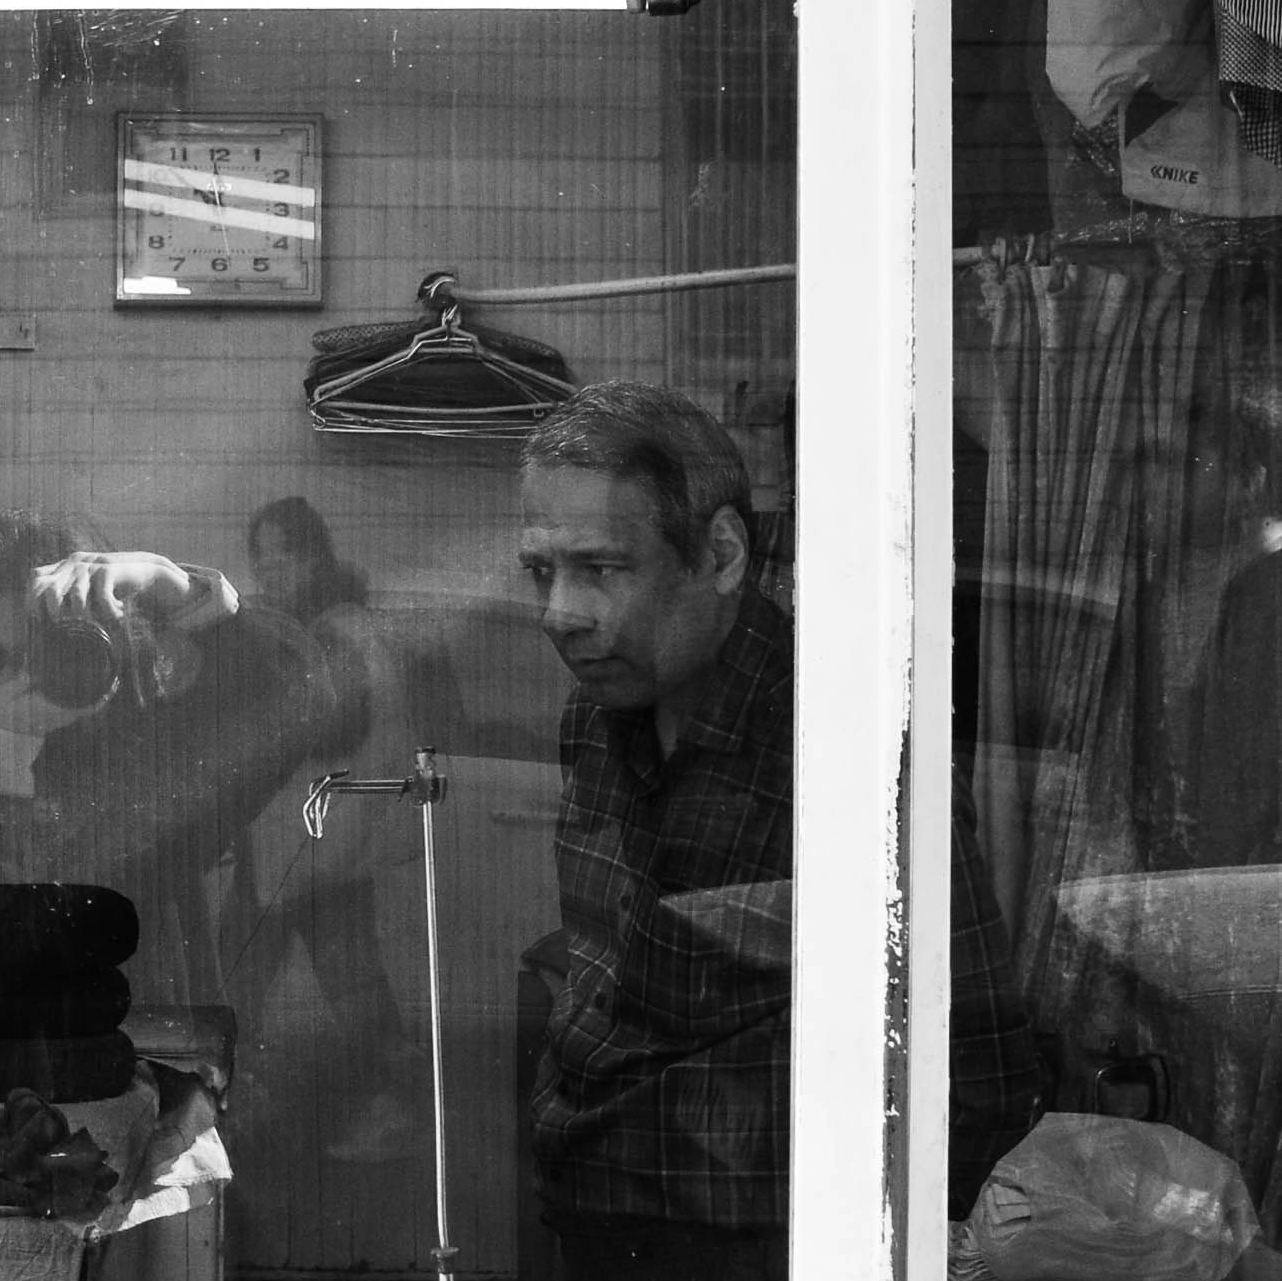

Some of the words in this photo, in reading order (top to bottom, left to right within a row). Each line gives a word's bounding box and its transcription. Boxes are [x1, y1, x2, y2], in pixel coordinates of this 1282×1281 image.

[170, 147, 188, 162] 11
[209, 148, 230, 162] 12
[253, 147, 261, 162] 1
[273, 169, 290, 184] 2
[1163, 166, 1199, 184] NIKE
[273, 202, 290, 217] 3
[148, 235, 165, 249] 8
[272, 236, 289, 250] 4
[169, 257, 185, 272] 7
[211, 257, 228, 272] 6
[253, 257, 270, 272] 5
